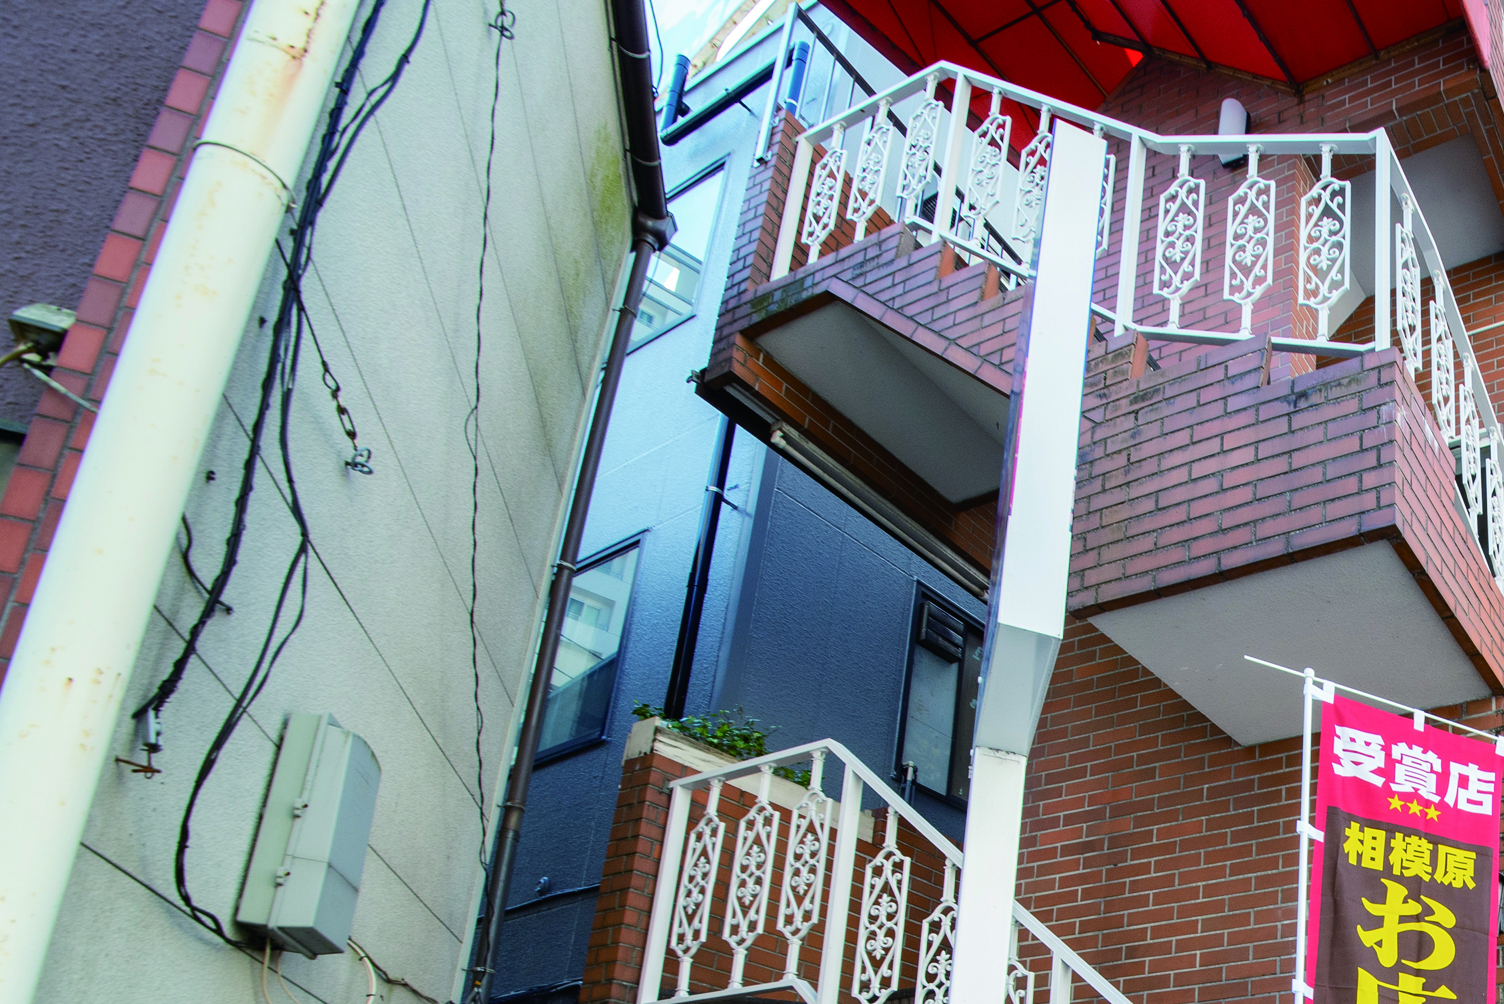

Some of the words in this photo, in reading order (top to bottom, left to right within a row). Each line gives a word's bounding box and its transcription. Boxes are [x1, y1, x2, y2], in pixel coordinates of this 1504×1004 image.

[1331, 724, 1496, 816] 受賞店
[1343, 821, 1477, 890] 相模原
